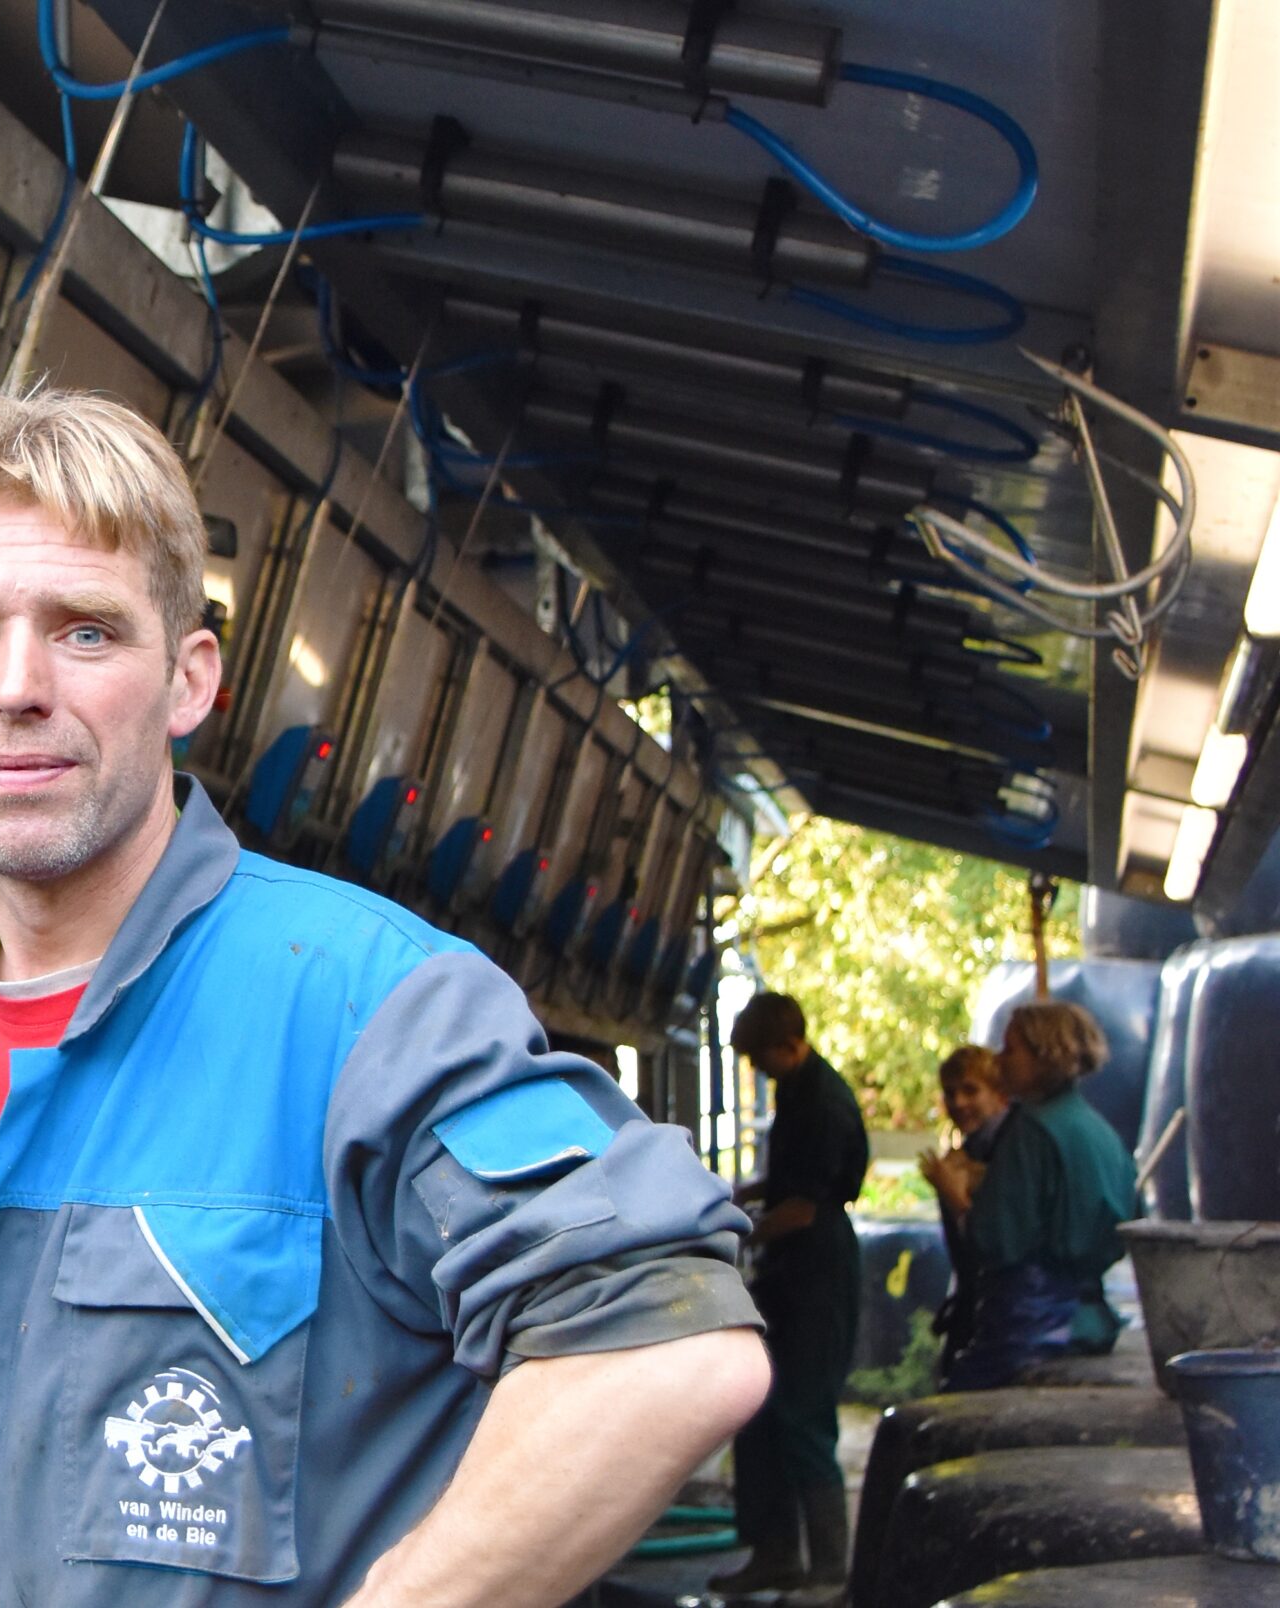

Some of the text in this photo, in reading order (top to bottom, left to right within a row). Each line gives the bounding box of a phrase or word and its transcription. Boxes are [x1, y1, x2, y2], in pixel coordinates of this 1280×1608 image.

[119, 1500, 227, 1524] van Winden
[126, 1524, 217, 1545] en de Bie
